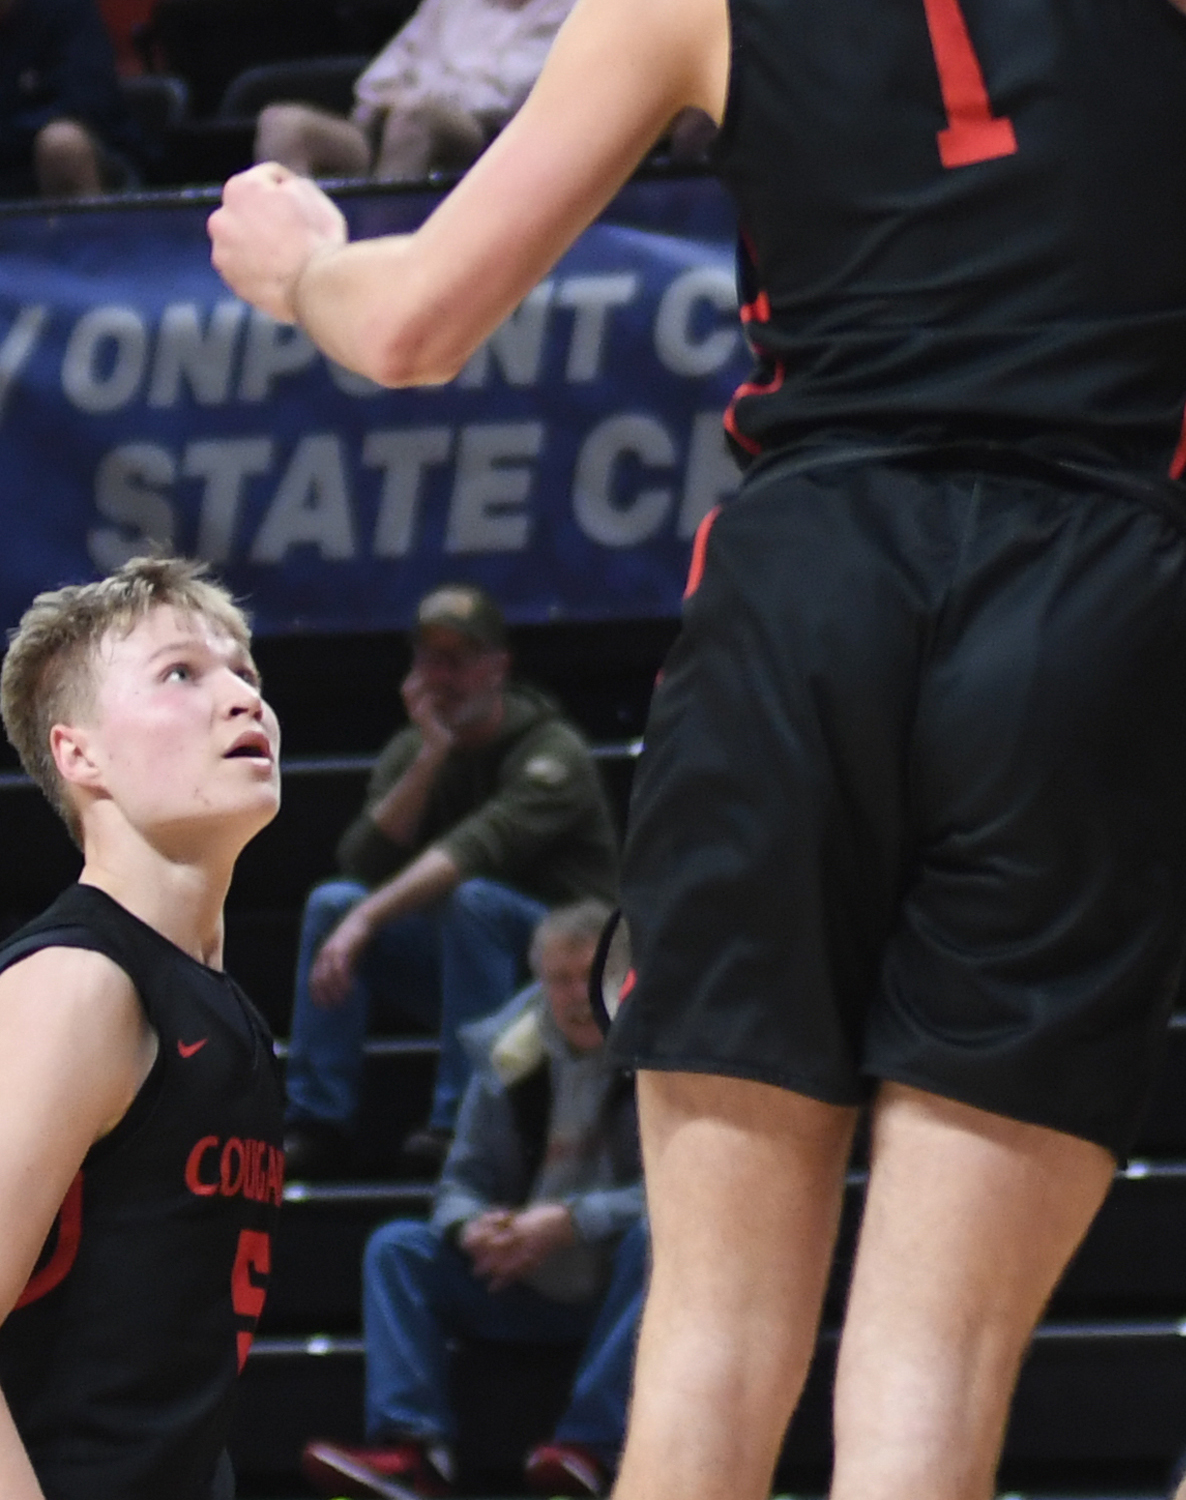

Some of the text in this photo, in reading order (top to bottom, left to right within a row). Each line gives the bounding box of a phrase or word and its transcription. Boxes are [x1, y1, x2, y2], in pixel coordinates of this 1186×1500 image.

[60, 270, 638, 413] ONPNT
[87, 421, 544, 568] STATE
[184, 1135, 285, 1207] COUGA
